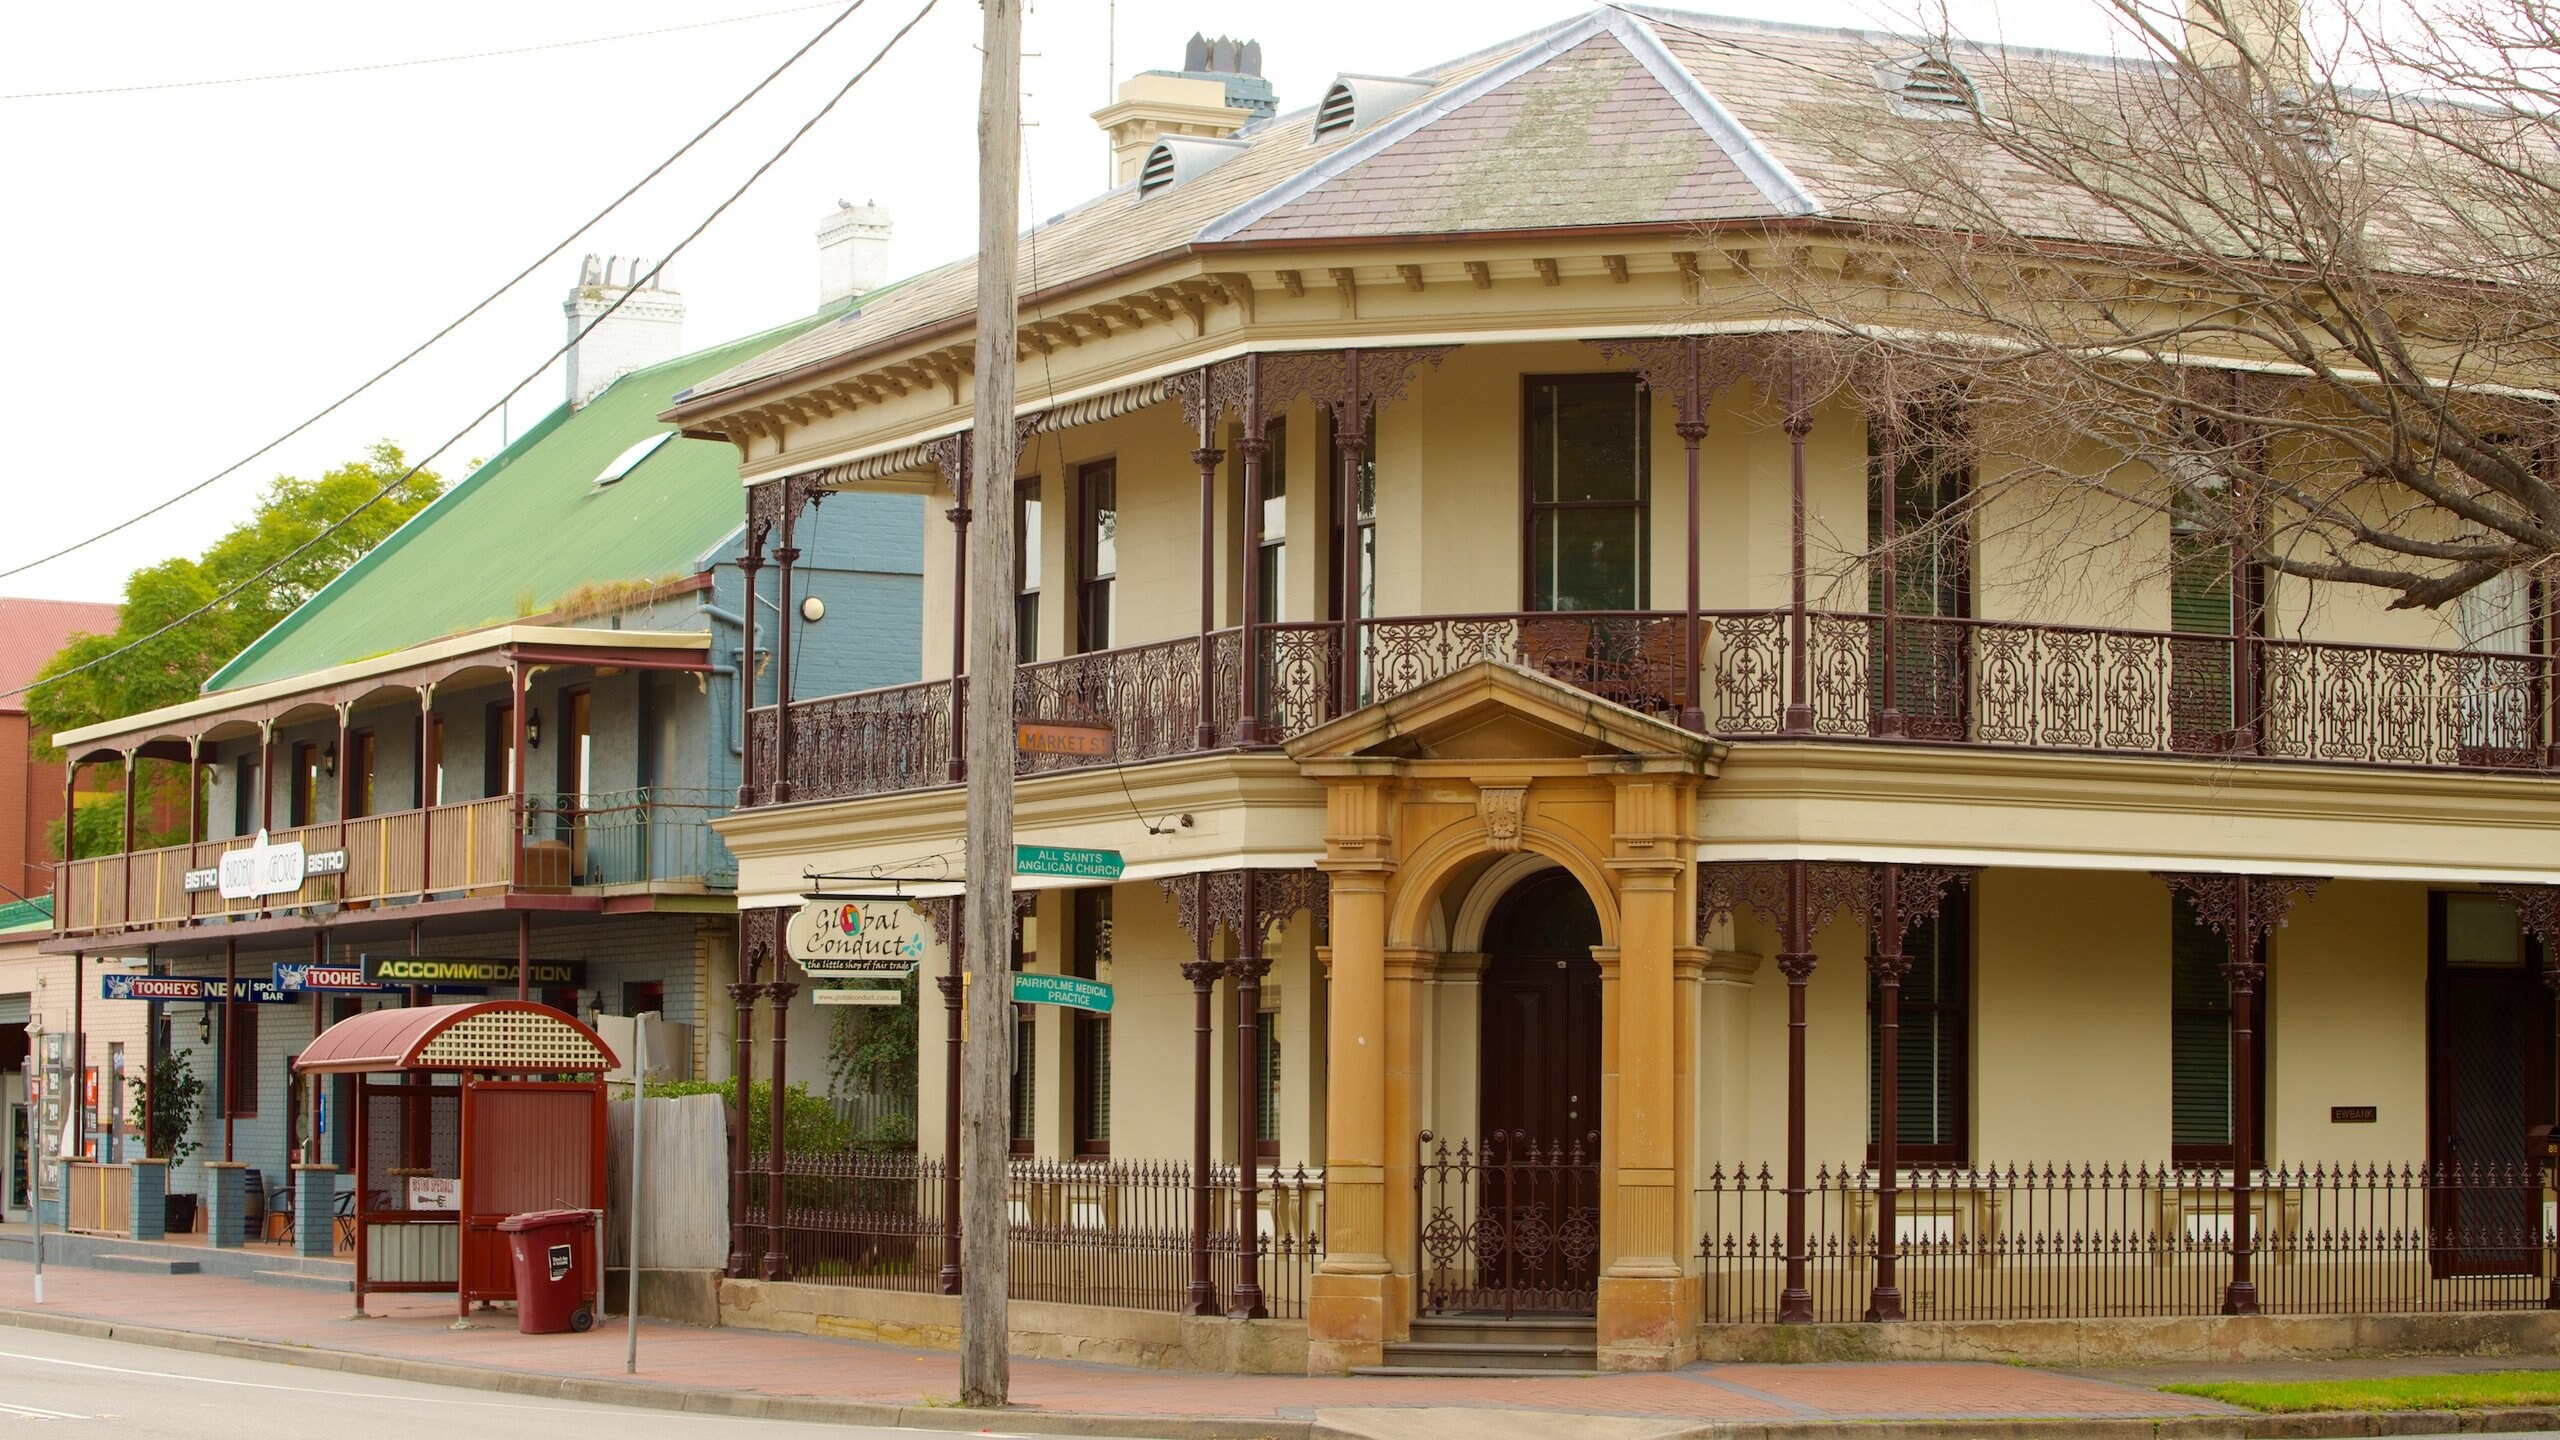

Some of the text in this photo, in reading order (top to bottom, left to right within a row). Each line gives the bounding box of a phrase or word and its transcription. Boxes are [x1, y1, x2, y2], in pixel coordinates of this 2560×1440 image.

[1024, 733, 1107, 754] MARKET ST
[308, 850, 344, 873] BISTRO
[1038, 850, 1103, 864] ALL SAINTS
[1018, 860, 1120, 876] ANGLICAN CHURCH
[185, 868, 218, 890] BISTRO
[815, 903, 900, 940] Global
[806, 931, 905, 960] Conduct
[377, 961, 572, 982] ACCOMMODATION
[807, 959, 910, 971] the little shop of fair trade
[310, 971, 378, 986] TOOHE
[136, 981, 247, 998] TOOHEYS NEW
[253, 982, 274, 992] SPO
[1016, 977, 1108, 998] FAIRHOLME MEDICAL
[262, 992, 284, 1001] BAR
[1048, 991, 1090, 1005] PRACTICE
[2336, 1109, 2373, 1119] EWBANK
